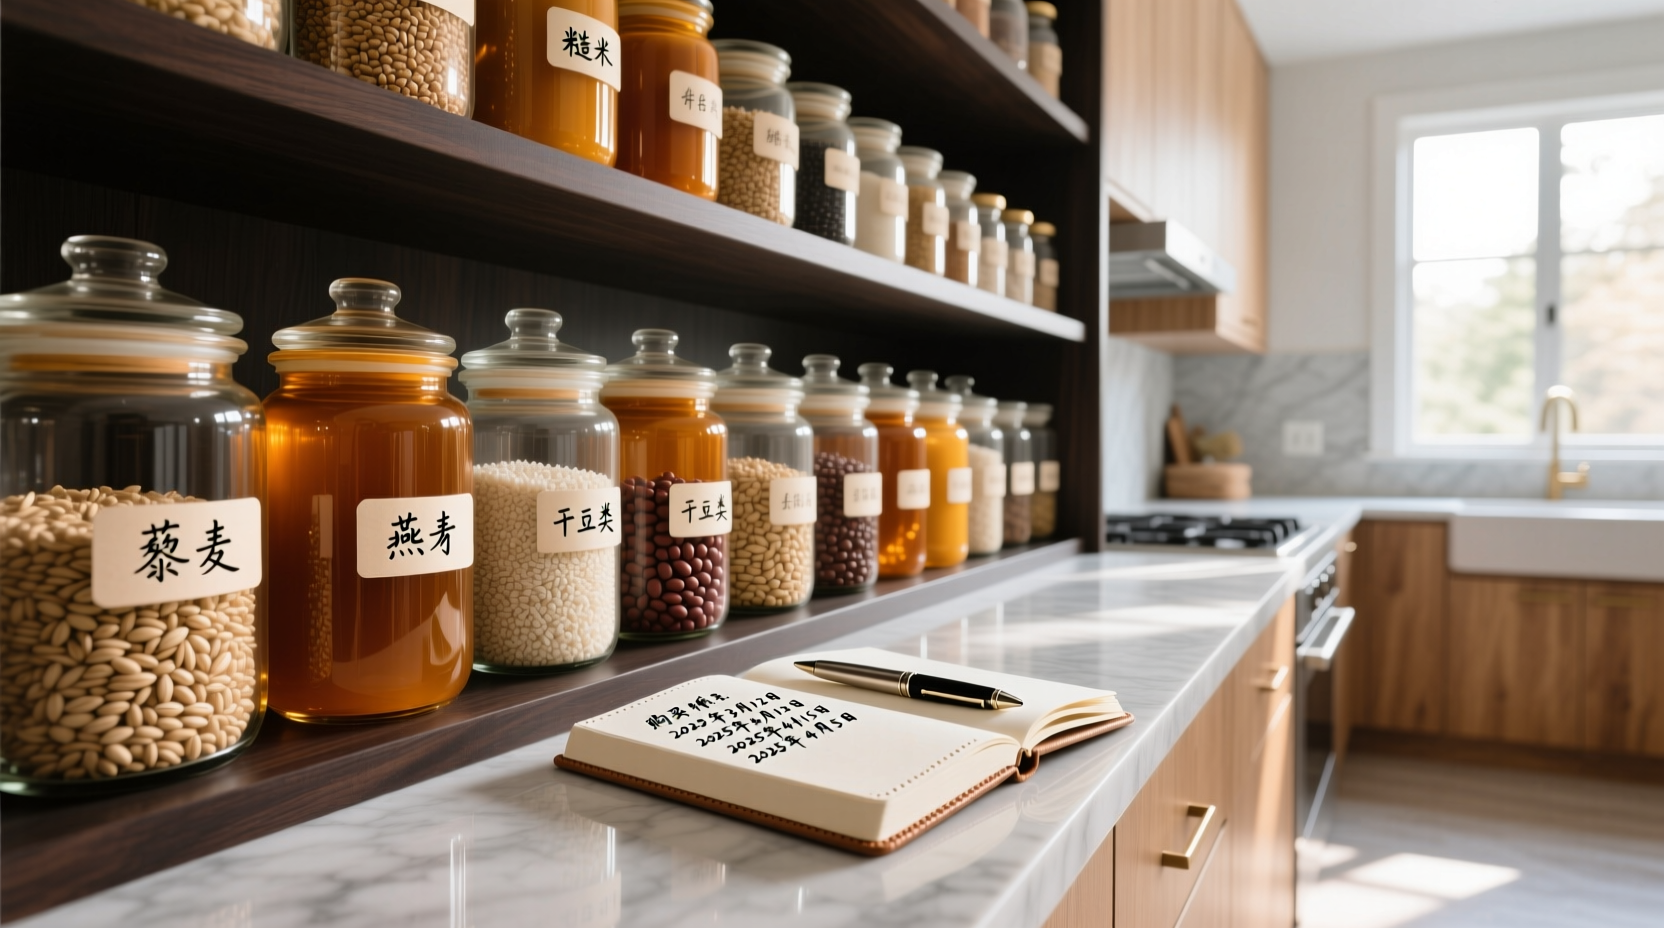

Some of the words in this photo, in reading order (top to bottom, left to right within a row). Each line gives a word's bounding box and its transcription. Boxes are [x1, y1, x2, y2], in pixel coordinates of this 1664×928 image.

[562, 26, 614, 67] 糙米
[553, 502, 614, 538] 干豆类
[681, 494, 728, 524] 干豆类
[134, 519, 240, 583] 藜麦
[747, 712, 858, 763] 2025年4月5日
